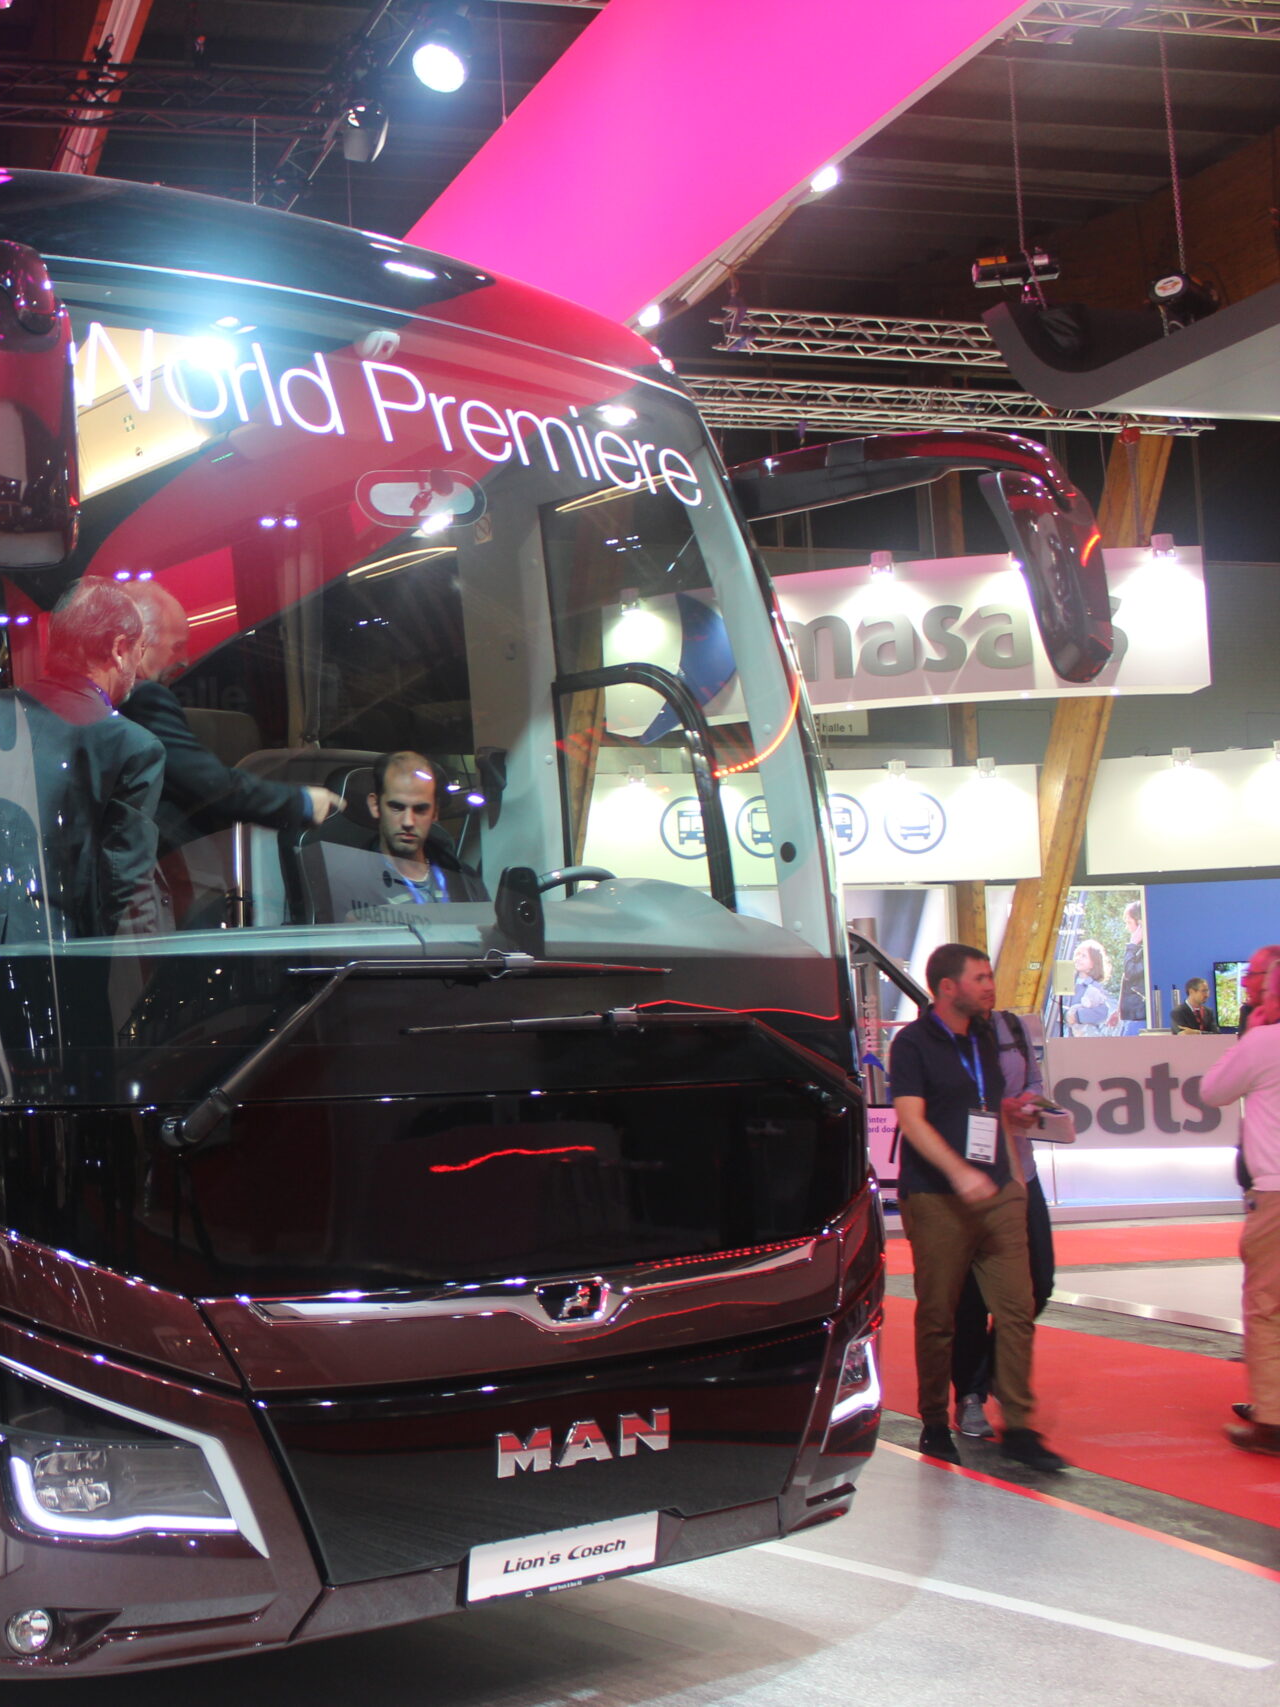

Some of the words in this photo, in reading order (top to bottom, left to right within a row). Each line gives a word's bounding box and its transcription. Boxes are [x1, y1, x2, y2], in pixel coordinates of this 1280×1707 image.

[73, 322, 345, 436] World
[362, 360, 702, 507] Premiere
[786, 595, 1128, 683] masa
[822, 723, 846, 732] halle
[1053, 1062, 1222, 1135] sats
[881, 1125, 897, 1133] doo
[496, 1408, 670, 1479] MAN
[66, 1478, 94, 1487] MAN
[568, 1538, 626, 1560] Coach
